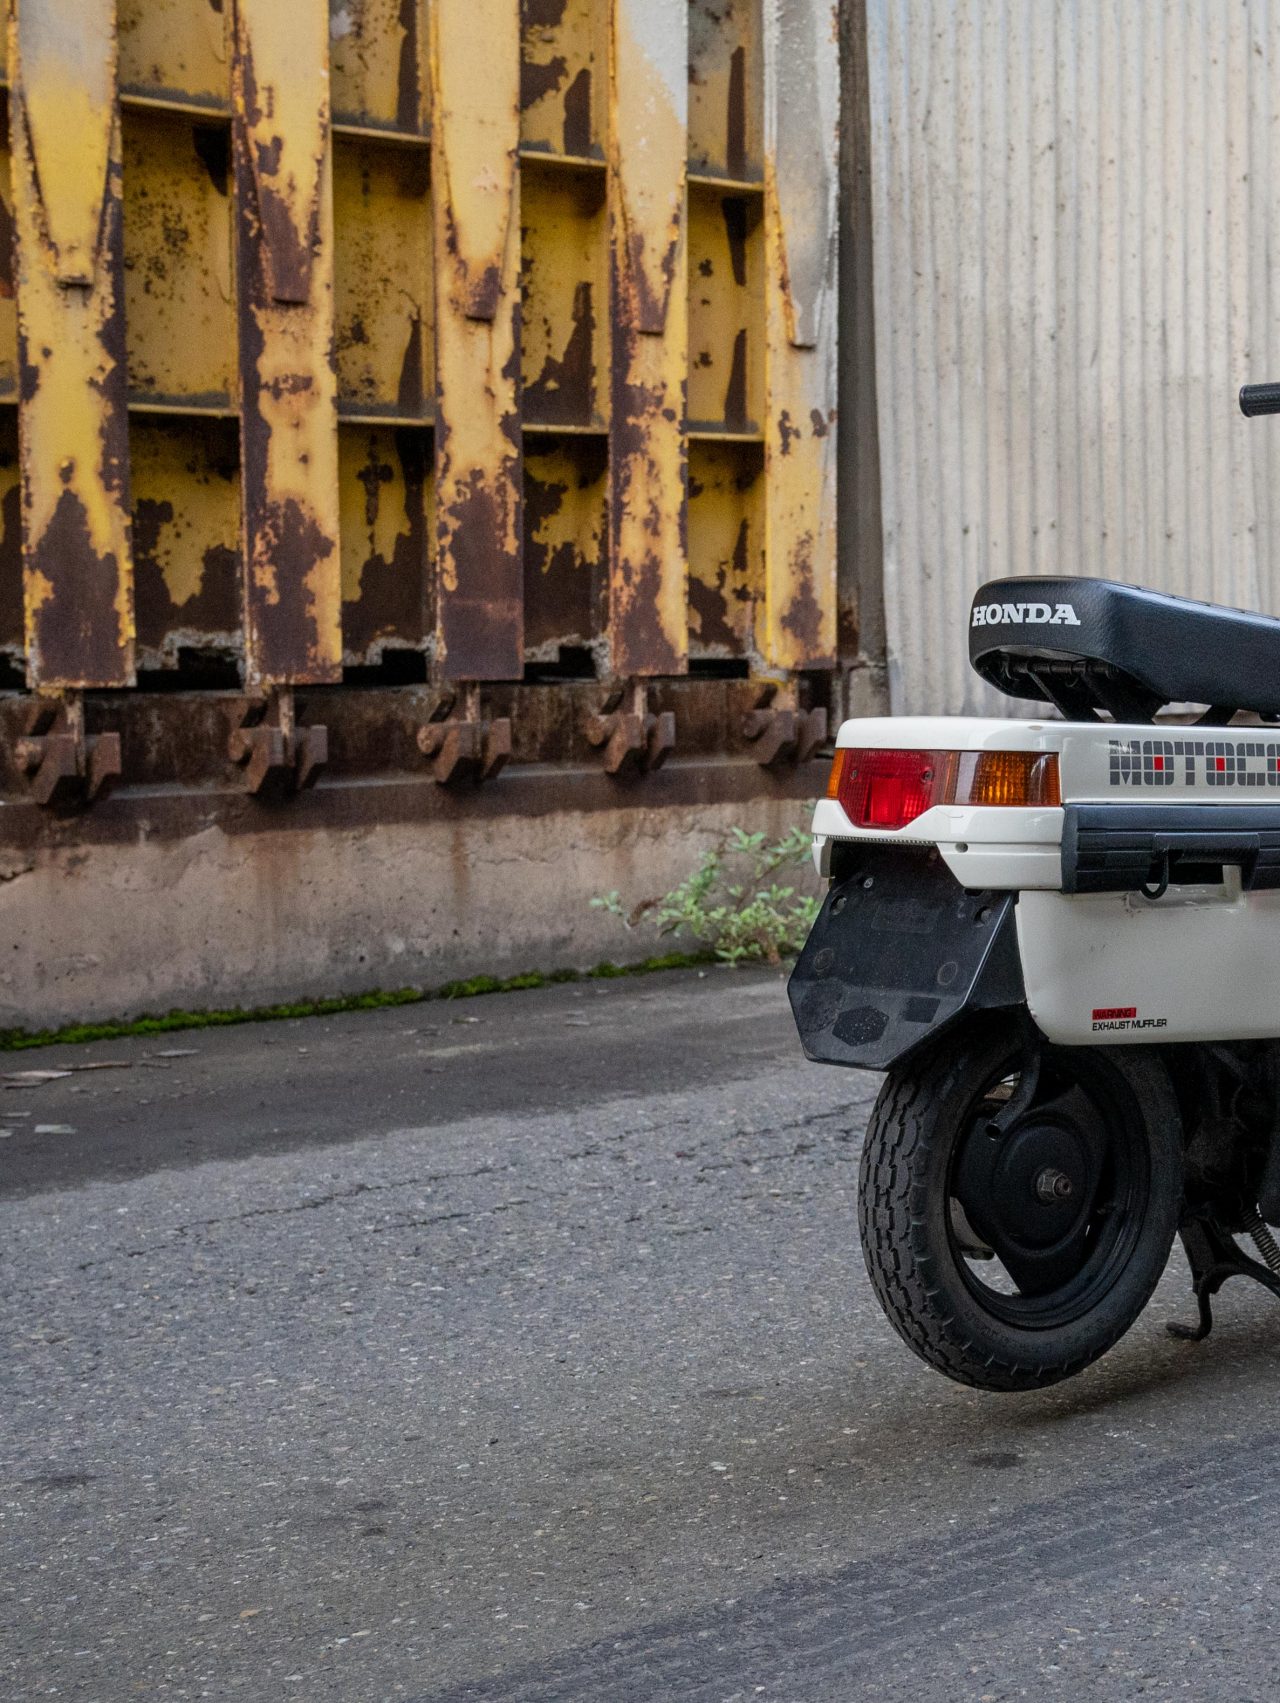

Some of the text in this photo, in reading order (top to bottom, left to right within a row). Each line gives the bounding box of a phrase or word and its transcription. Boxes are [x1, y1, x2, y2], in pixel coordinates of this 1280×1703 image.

[972, 603, 1081, 627] HONDA
[1092, 1008, 1132, 1020] WARNING
[1092, 1018, 1167, 1031] EXHAUST MUFFLER
